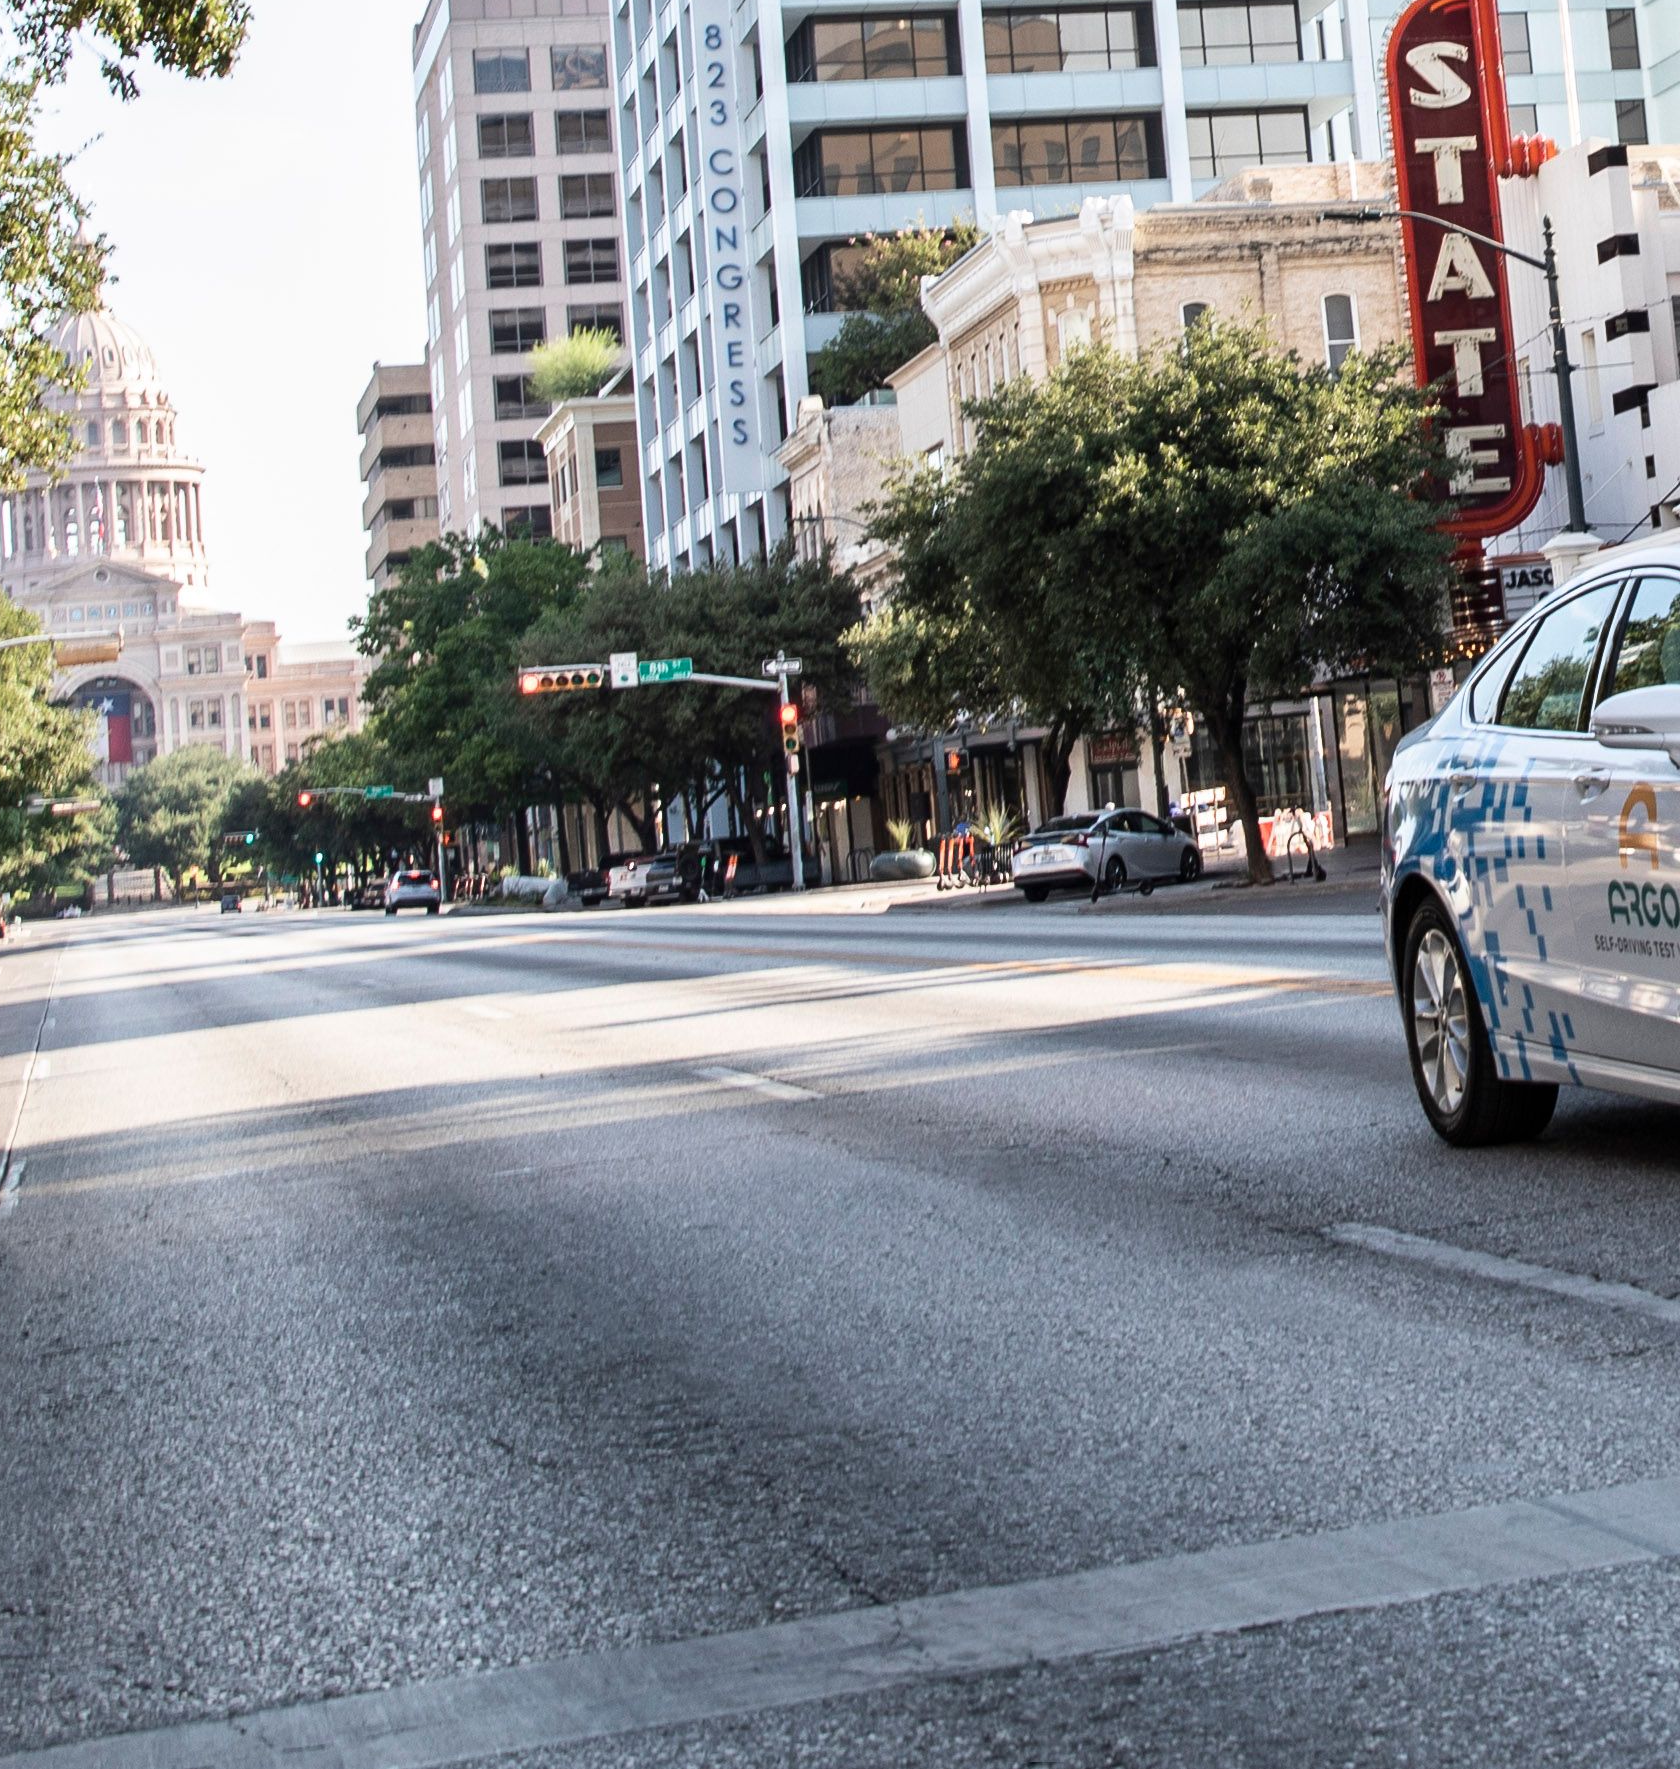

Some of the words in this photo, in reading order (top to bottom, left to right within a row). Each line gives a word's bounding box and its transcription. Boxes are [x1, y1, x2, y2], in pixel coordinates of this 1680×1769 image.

[704, 24, 728, 126] 823
[709, 149, 749, 446] CONGRESS
[1405, 41, 1511, 495] STATE
[1594, 934, 1653, 957] SELF-DRIVING
[1653, 940, 1676, 959] TEST
[1607, 879, 1680, 929] ARGO
